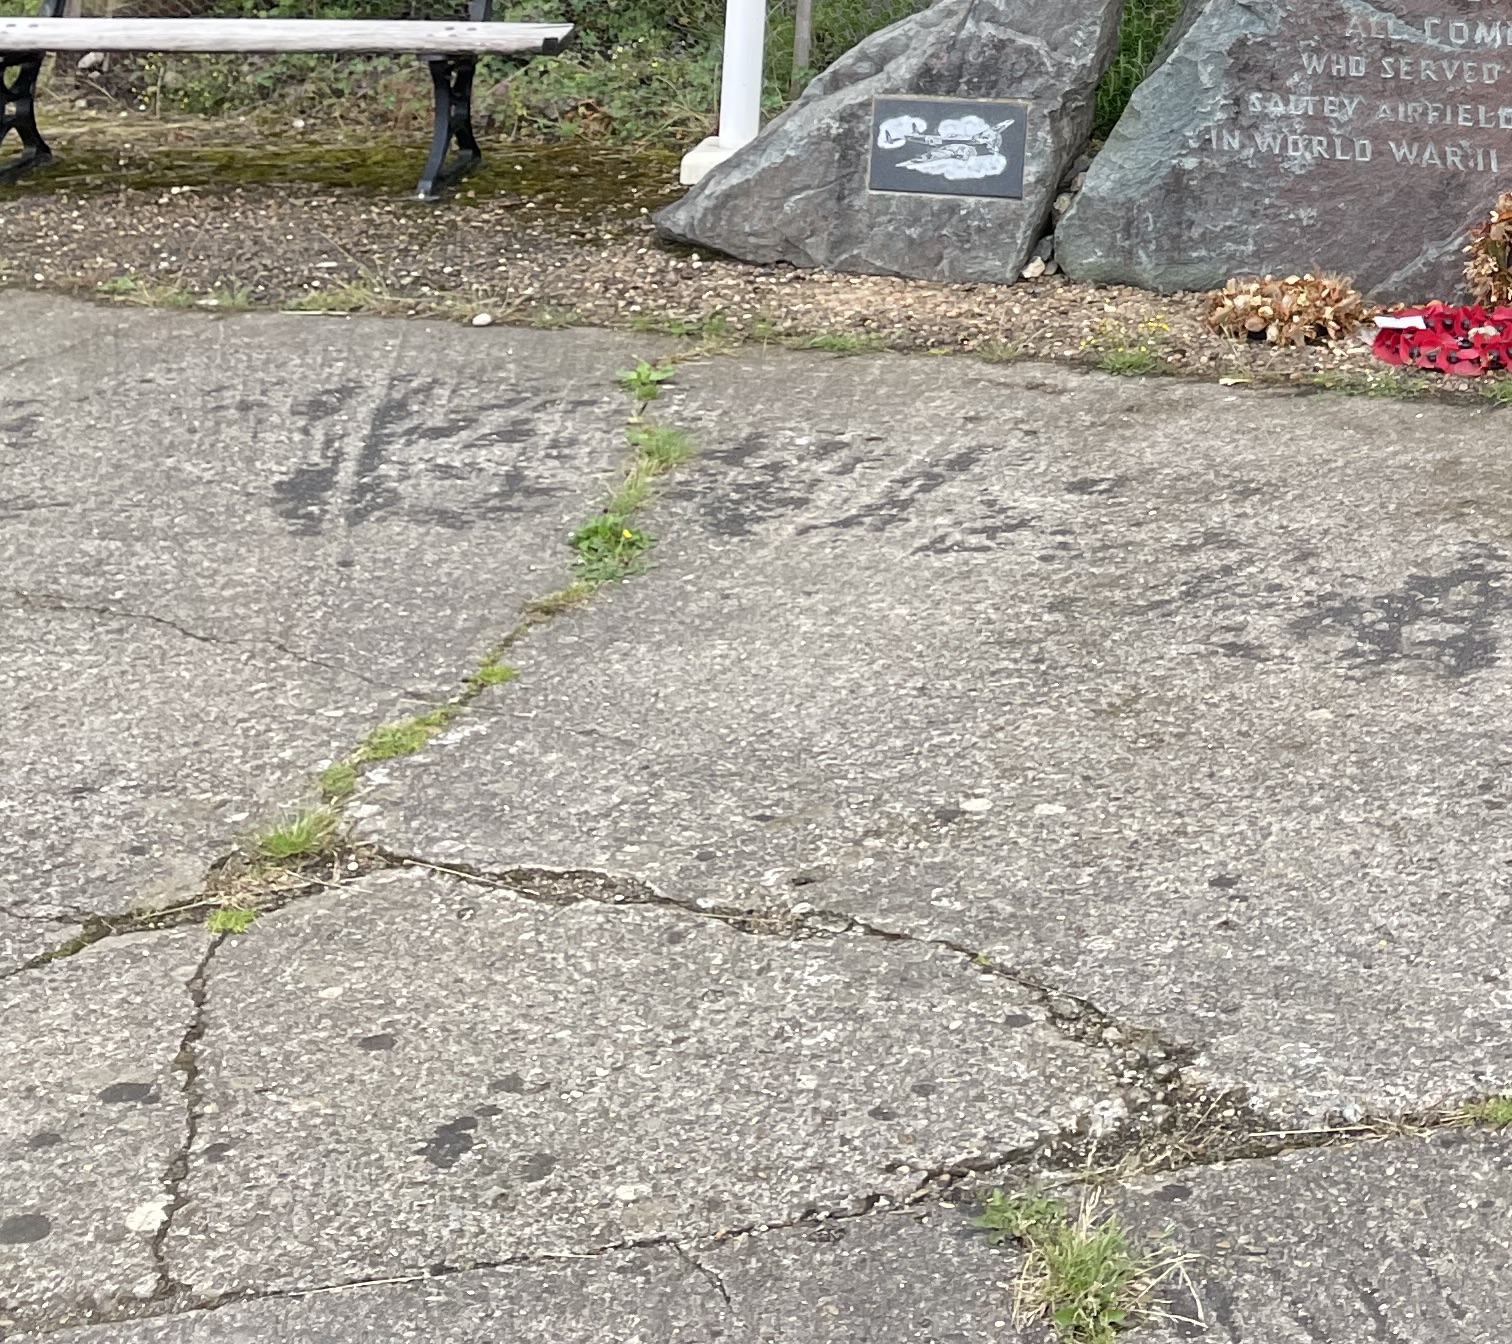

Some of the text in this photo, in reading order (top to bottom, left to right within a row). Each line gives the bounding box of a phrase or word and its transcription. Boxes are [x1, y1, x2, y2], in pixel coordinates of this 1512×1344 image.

[1345, 16, 1402, 40] ALL
[1301, 52, 1366, 77] WHO
[1380, 56, 1501, 84] SERVED
[1210, 124, 1499, 173] IN WORLD WAR II
